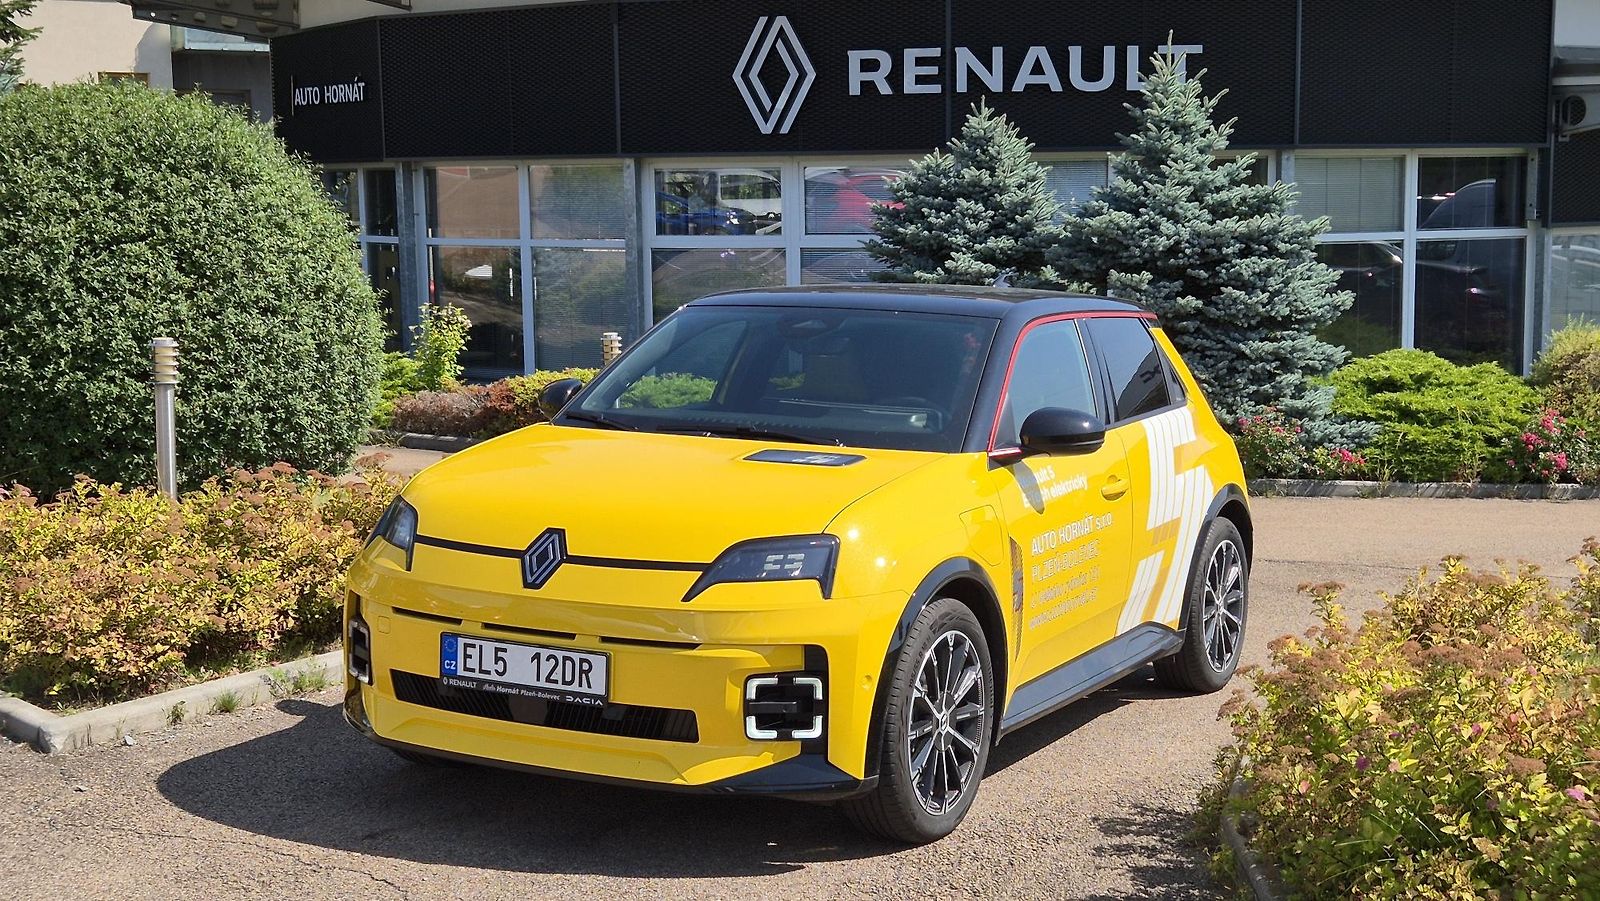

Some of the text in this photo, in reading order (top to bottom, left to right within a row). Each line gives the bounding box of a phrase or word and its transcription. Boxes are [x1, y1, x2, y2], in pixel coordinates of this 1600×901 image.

[847, 45, 1203, 96] RENAULT
[295, 76, 365, 106] AUTO HORNÁT
[1032, 529, 1056, 556] AUTO
[1058, 512, 1094, 545] HORNÁT
[444, 660, 457, 670] CZ
[463, 642, 593, 689] EL5 12DR
[448, 679, 477, 688] RENAULT
[496, 685, 519, 695] Hornát
[565, 695, 603, 706] DACIA
